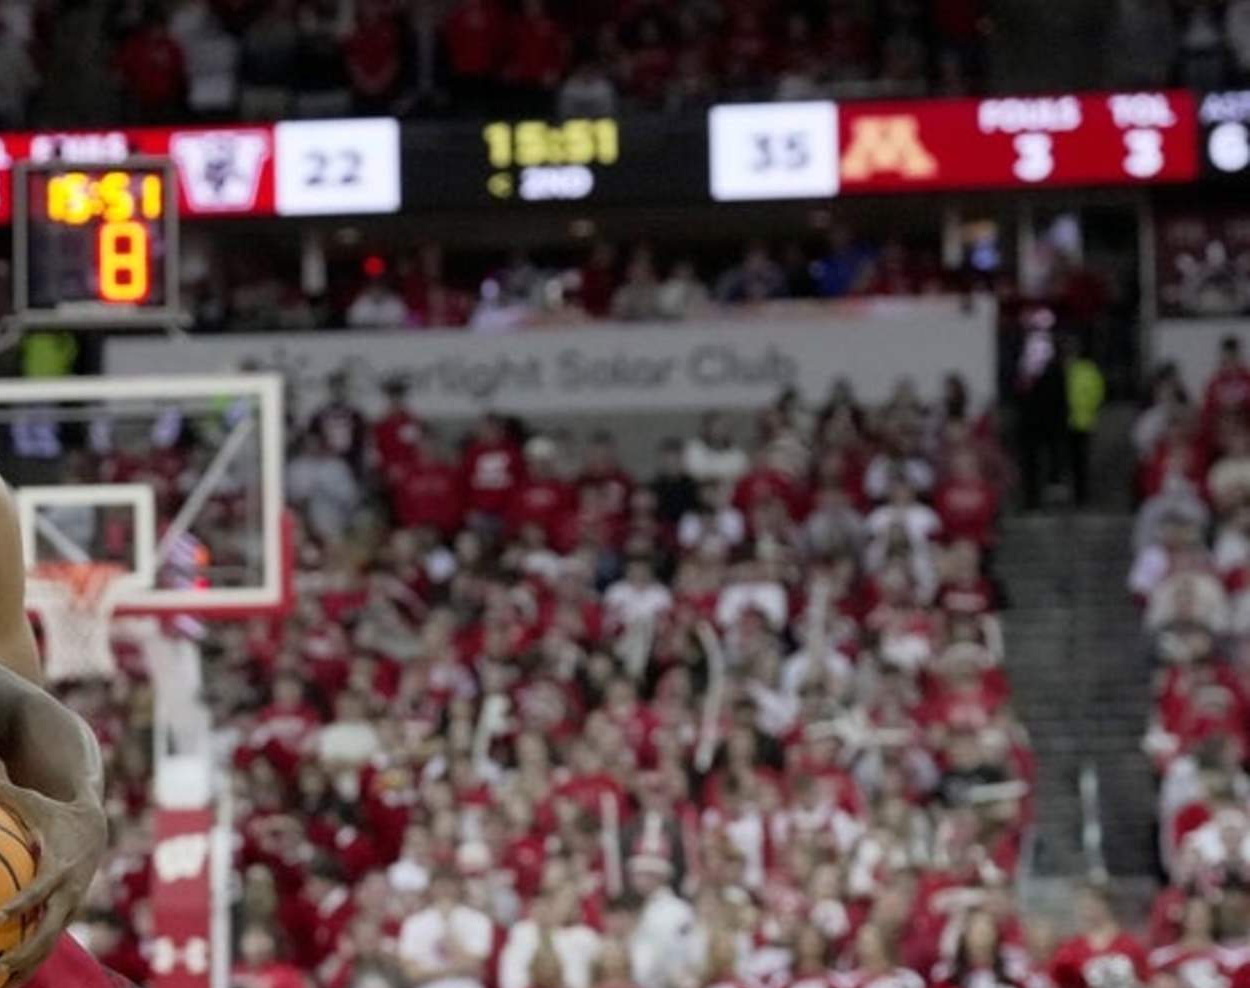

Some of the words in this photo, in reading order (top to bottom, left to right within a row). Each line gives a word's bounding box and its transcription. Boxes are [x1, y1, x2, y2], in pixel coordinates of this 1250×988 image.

[305, 150, 364, 187] 22
[750, 131, 811, 172] 35
[1013, 132, 1054, 182] 3
[1123, 129, 1164, 178] 3
[99, 221, 149, 302] 8
